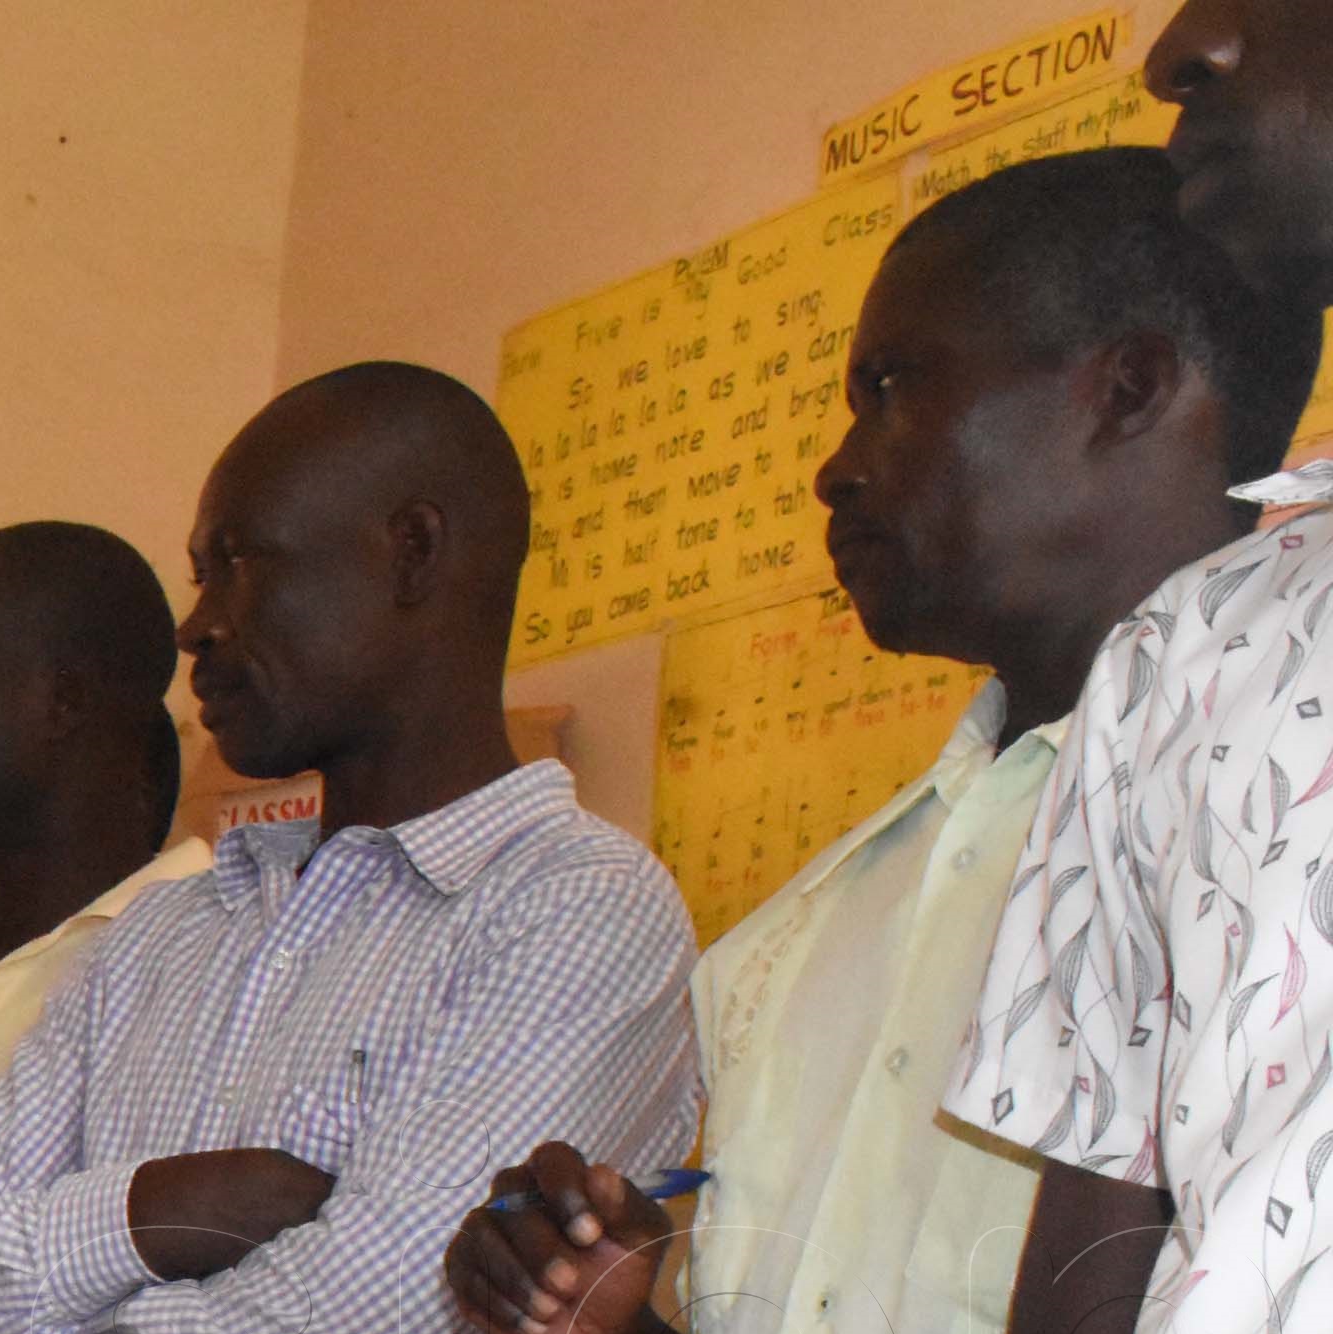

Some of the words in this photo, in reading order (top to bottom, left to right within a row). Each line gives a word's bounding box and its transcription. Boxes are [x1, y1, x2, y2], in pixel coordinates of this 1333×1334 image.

[825, 94, 922, 174] MUSIC
[951, 17, 1118, 117] SECTION
[823, 204, 892, 247] Class
[665, 336, 708, 372] love
[733, 315, 751, 344] to
[709, 371, 736, 400] as
[756, 350, 790, 386] we
[808, 322, 854, 363] dan
[732, 396, 769, 440] and
[788, 369, 840, 420] brigh
[525, 611, 550, 645] So
